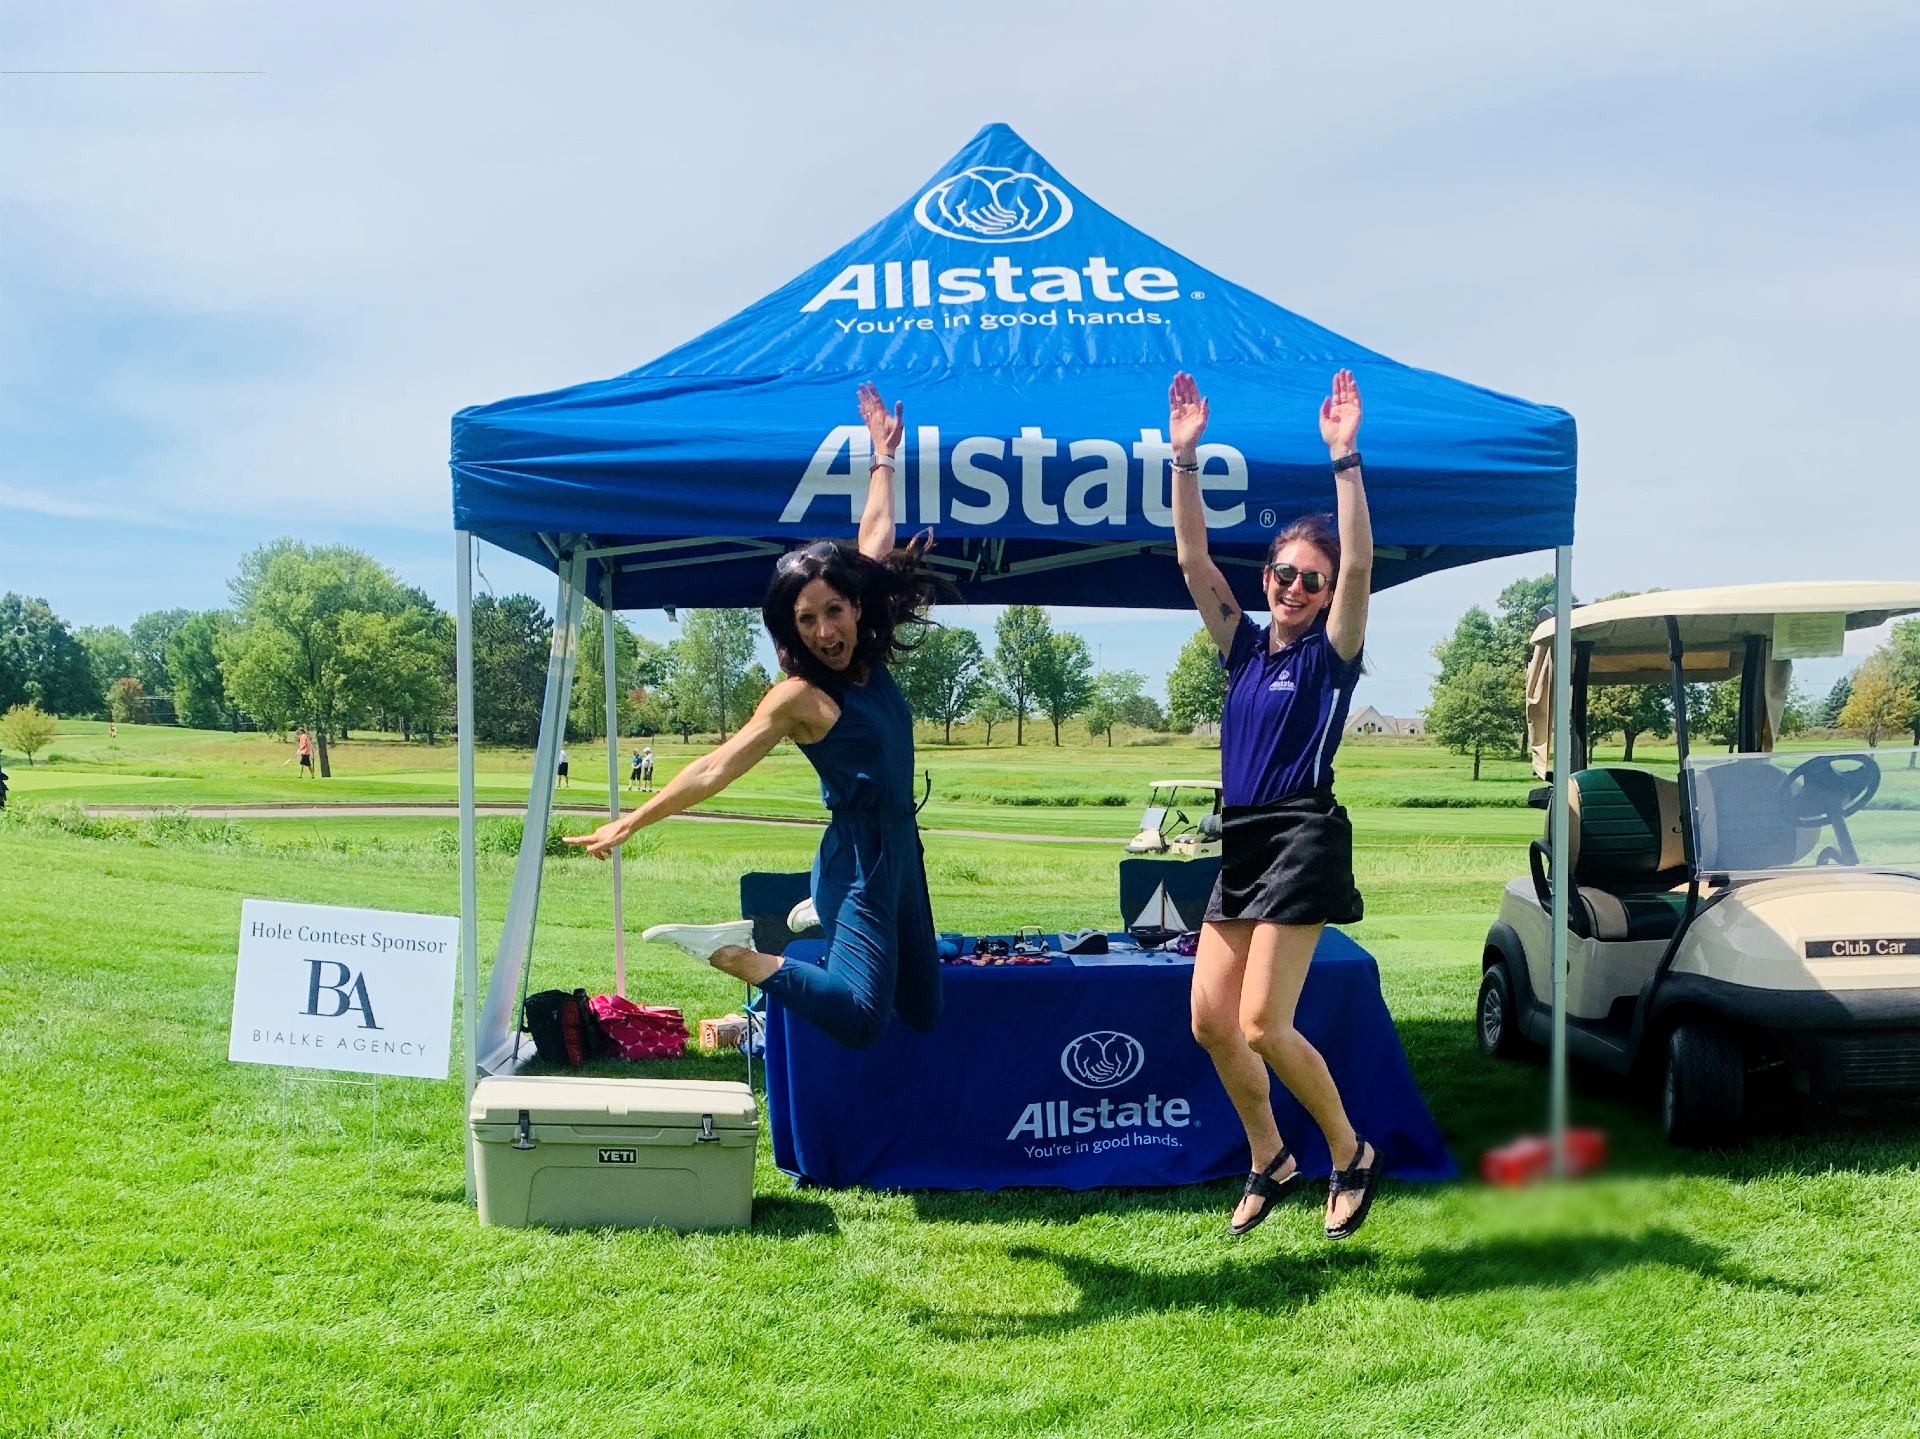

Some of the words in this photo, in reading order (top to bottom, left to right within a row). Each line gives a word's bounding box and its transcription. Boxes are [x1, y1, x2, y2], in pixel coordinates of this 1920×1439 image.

[800, 256, 1180, 312] Allstate
[835, 315, 934, 334] You're
[944, 312, 970, 329] in
[979, 308, 1057, 330] good
[1067, 307, 1171, 326] hands.
[778, 425, 1247, 529] Allstate
[251, 921, 292, 940] Hole
[298, 925, 367, 947] Contest
[371, 932, 447, 953] Sponsor
[1831, 940, 1871, 956] Club
[1875, 939, 1906, 955] Car
[299, 958, 384, 1030] BA
[252, 1029, 324, 1048] BIALKE
[336, 1037, 427, 1056] AGENCY
[1006, 1094, 1191, 1140] Allstate
[600, 1150, 634, 1162] YETI
[1024, 1143, 1072, 1158] You're
[1076, 1141, 1089, 1153] in
[1093, 1133, 1130, 1153] good
[1133, 1131, 1183, 1147] hands.
